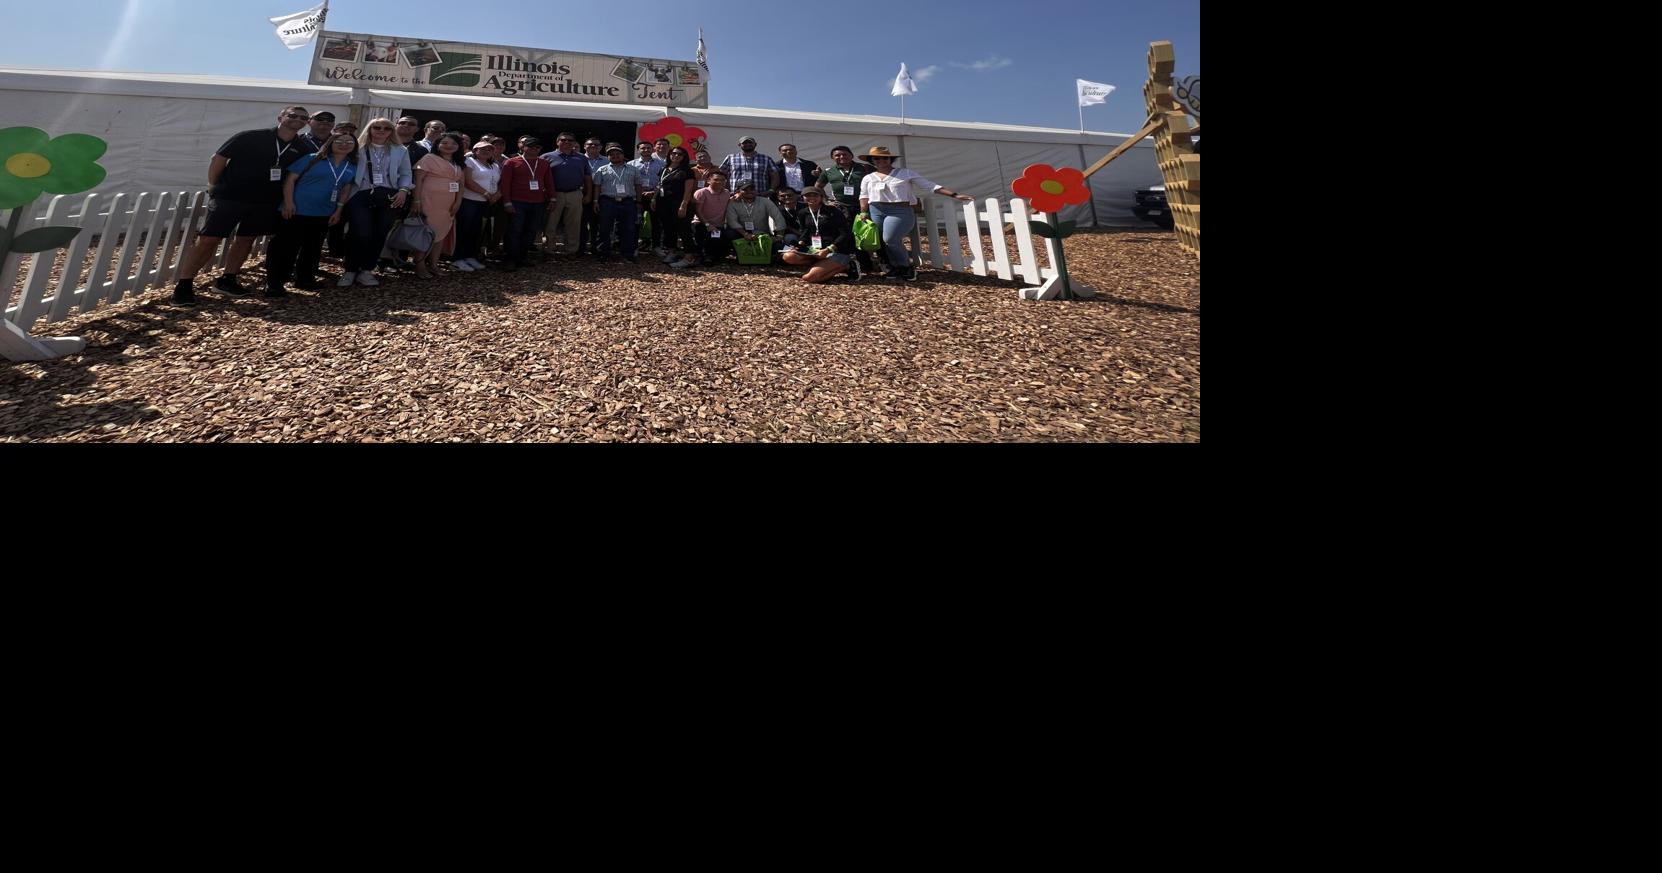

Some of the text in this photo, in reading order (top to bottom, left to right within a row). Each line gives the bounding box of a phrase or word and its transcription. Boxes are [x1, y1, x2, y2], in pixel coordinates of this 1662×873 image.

[487, 54, 571, 76] Illinois
[325, 66, 399, 83] Welcome
[412, 77, 426, 85] the
[498, 71, 553, 81] Department
[482, 74, 620, 97] Agriculture
[631, 82, 684, 100] Tent
